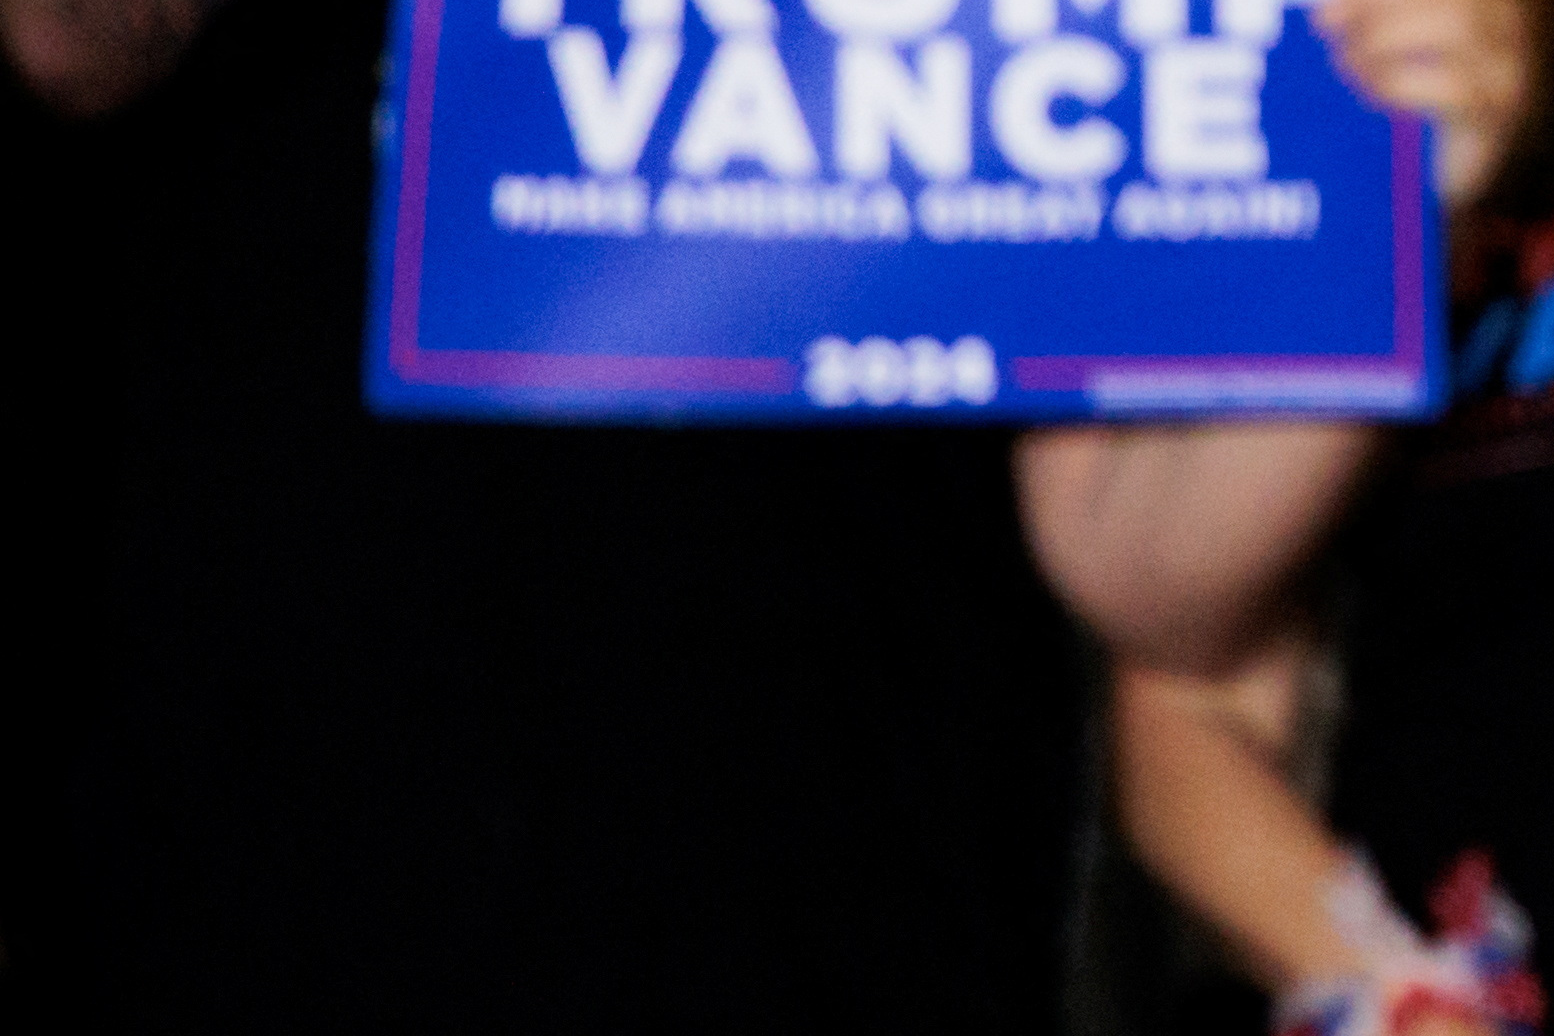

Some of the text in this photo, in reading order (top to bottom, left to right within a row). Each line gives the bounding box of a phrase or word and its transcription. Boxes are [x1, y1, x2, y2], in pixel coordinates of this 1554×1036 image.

[546, 24, 1271, 185] VANCE
[491, 174, 1322, 244] MAKE AMERICA GREAT AGAIN!
[804, 334, 998, 408] 2024
